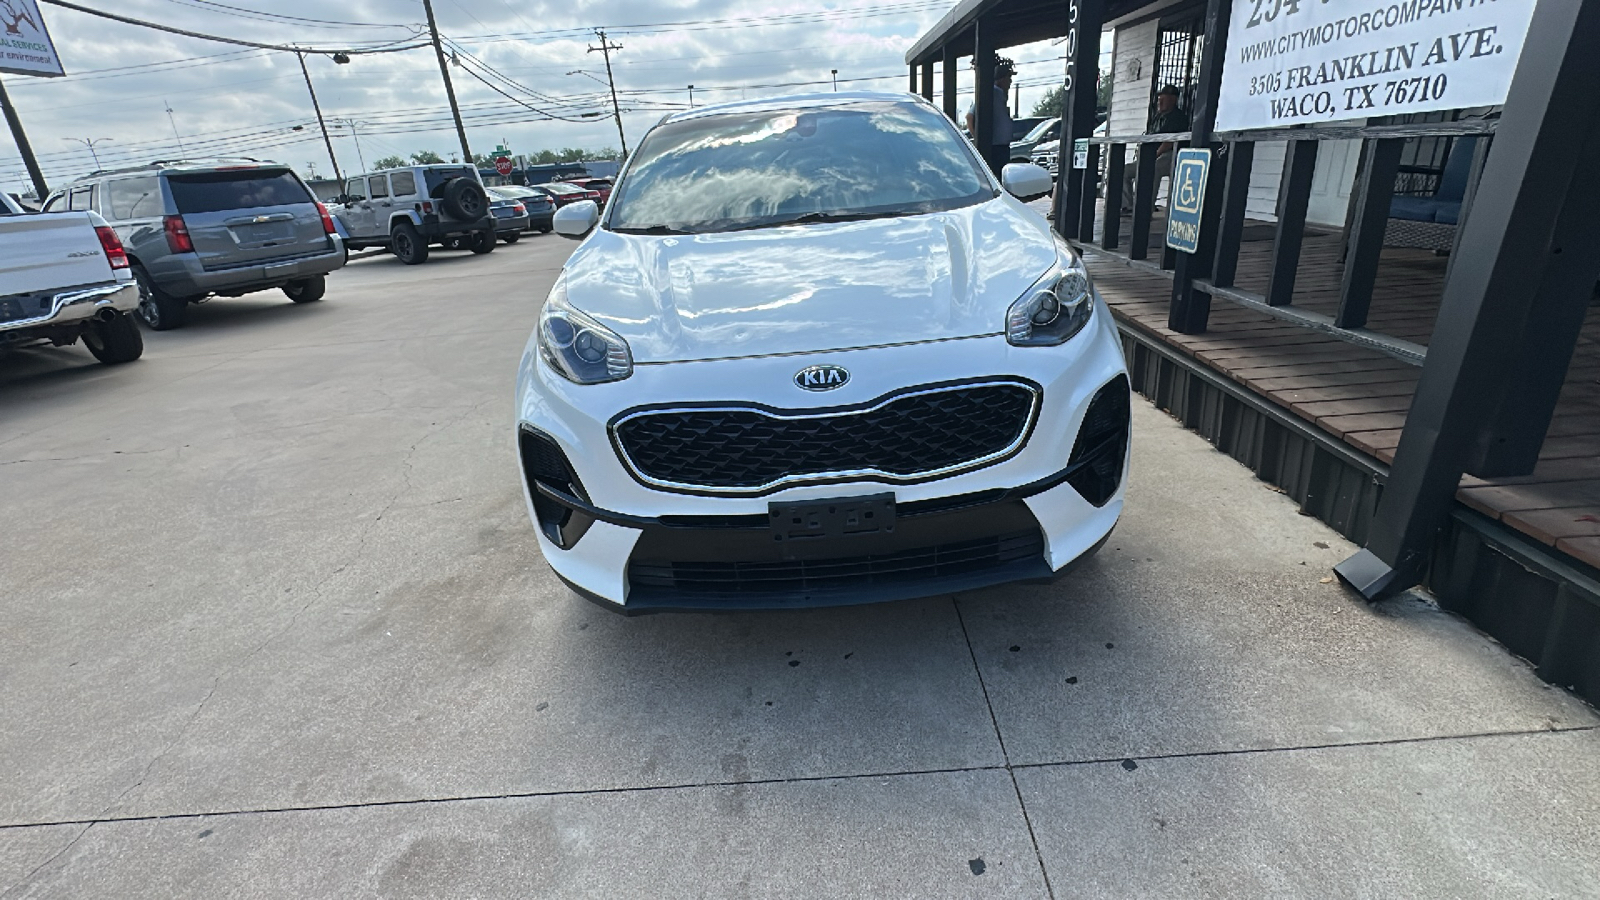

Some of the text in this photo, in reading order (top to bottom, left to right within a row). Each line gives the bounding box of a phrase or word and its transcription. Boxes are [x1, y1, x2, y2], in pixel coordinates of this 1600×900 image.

[1249, 26, 1504, 96] 3505 FRANKLIN AVE.
[1270, 73, 1448, 119] WACO, TX 76710
[496, 162, 510, 171] STOP
[1170, 219, 1197, 244] PARKING
[804, 369, 842, 386] KIA
